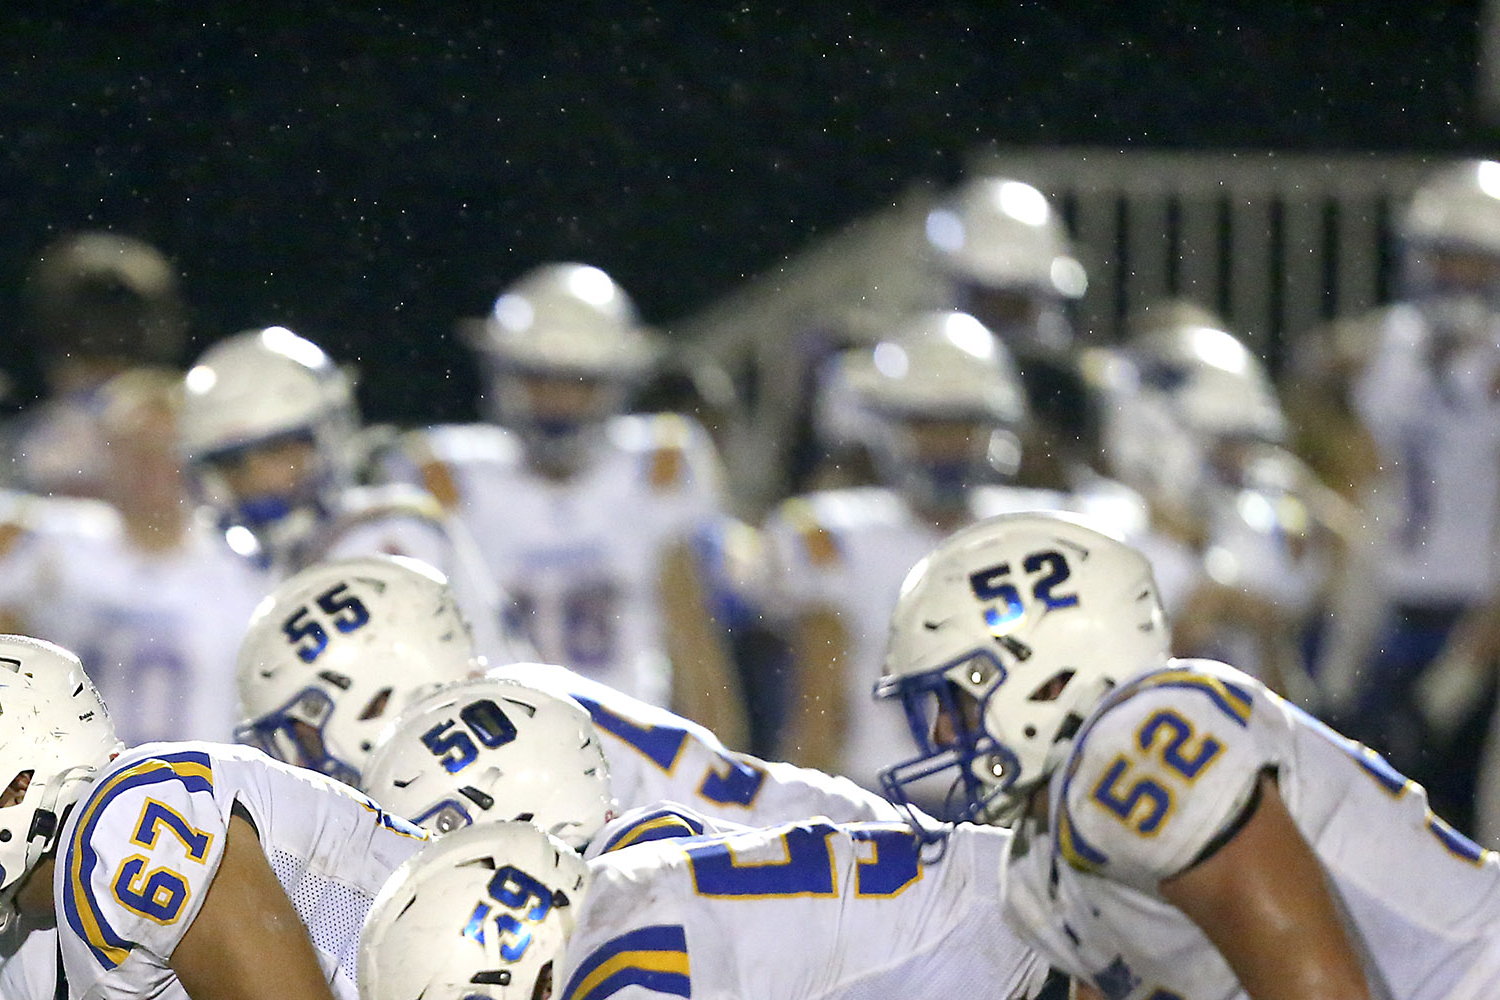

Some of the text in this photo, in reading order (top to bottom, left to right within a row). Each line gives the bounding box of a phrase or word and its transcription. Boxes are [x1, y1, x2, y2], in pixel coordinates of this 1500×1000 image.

[282, 582, 371, 665] 55
[968, 549, 1080, 637] 52
[419, 698, 517, 776] 50
[1088, 706, 1228, 839] 52
[109, 796, 214, 926] 67
[460, 864, 554, 965] 59
